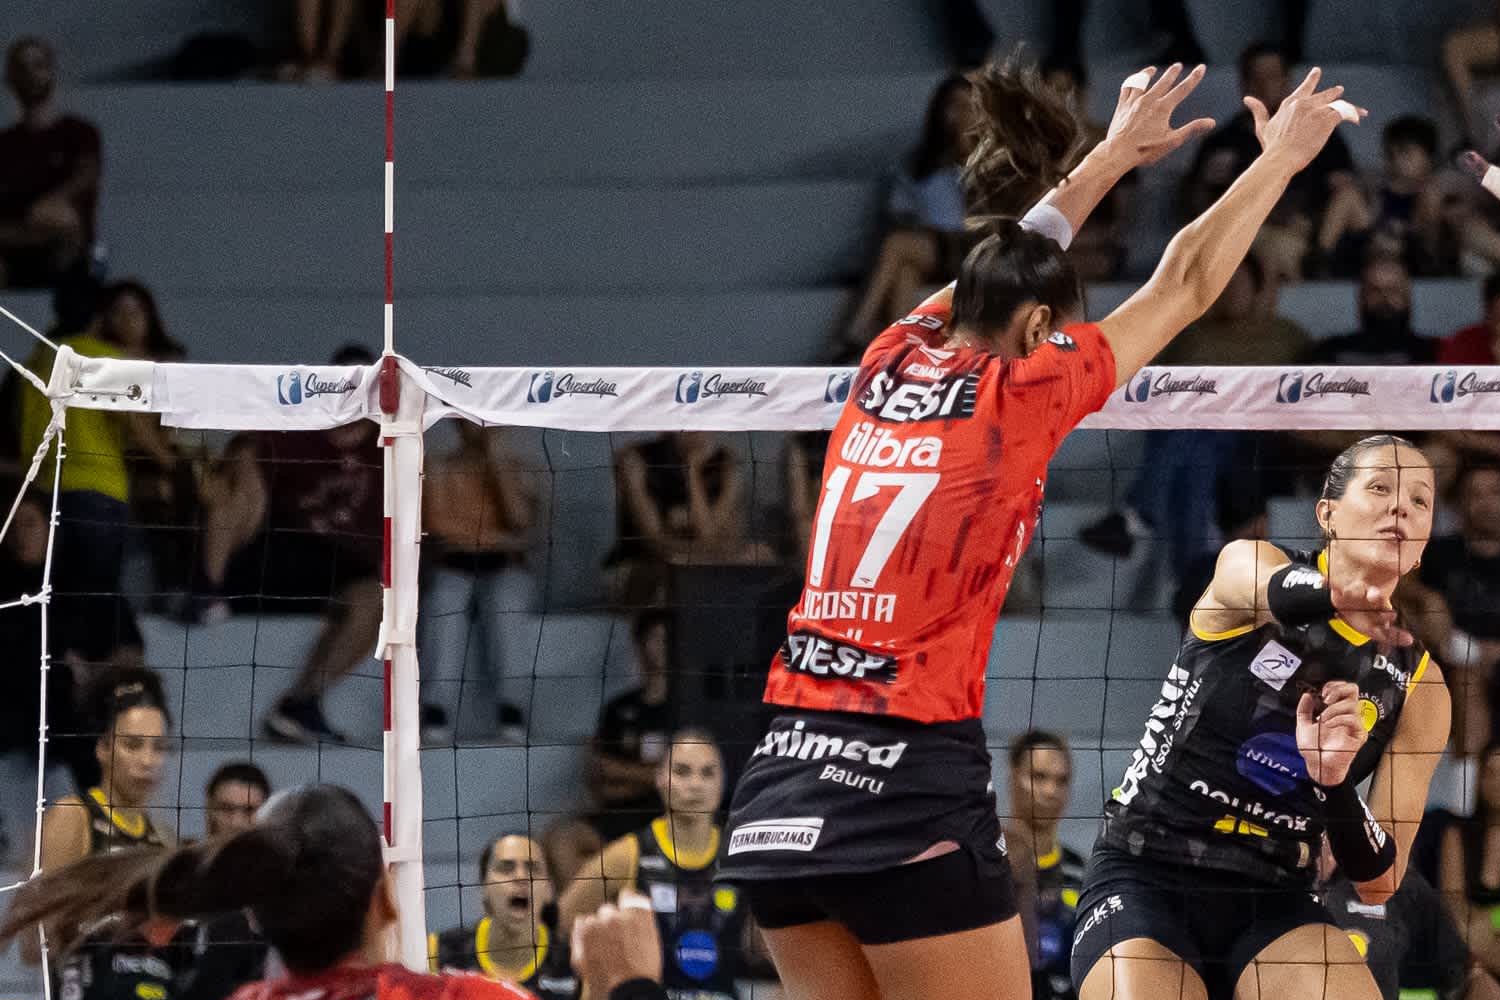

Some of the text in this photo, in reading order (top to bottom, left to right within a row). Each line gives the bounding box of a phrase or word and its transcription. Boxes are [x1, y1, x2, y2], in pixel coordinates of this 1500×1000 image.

[553, 373, 619, 397] Superliga
[701, 374, 768, 398] Superliga
[863, 371, 965, 422] SESI
[1150, 372, 1218, 398] Superliga
[1303, 372, 1371, 397] Superliga
[841, 421, 943, 467] tilibra
[808, 464, 942, 589] 17
[819, 764, 884, 795] Bauru
[731, 831, 814, 850] PERNAMBUCANAS
